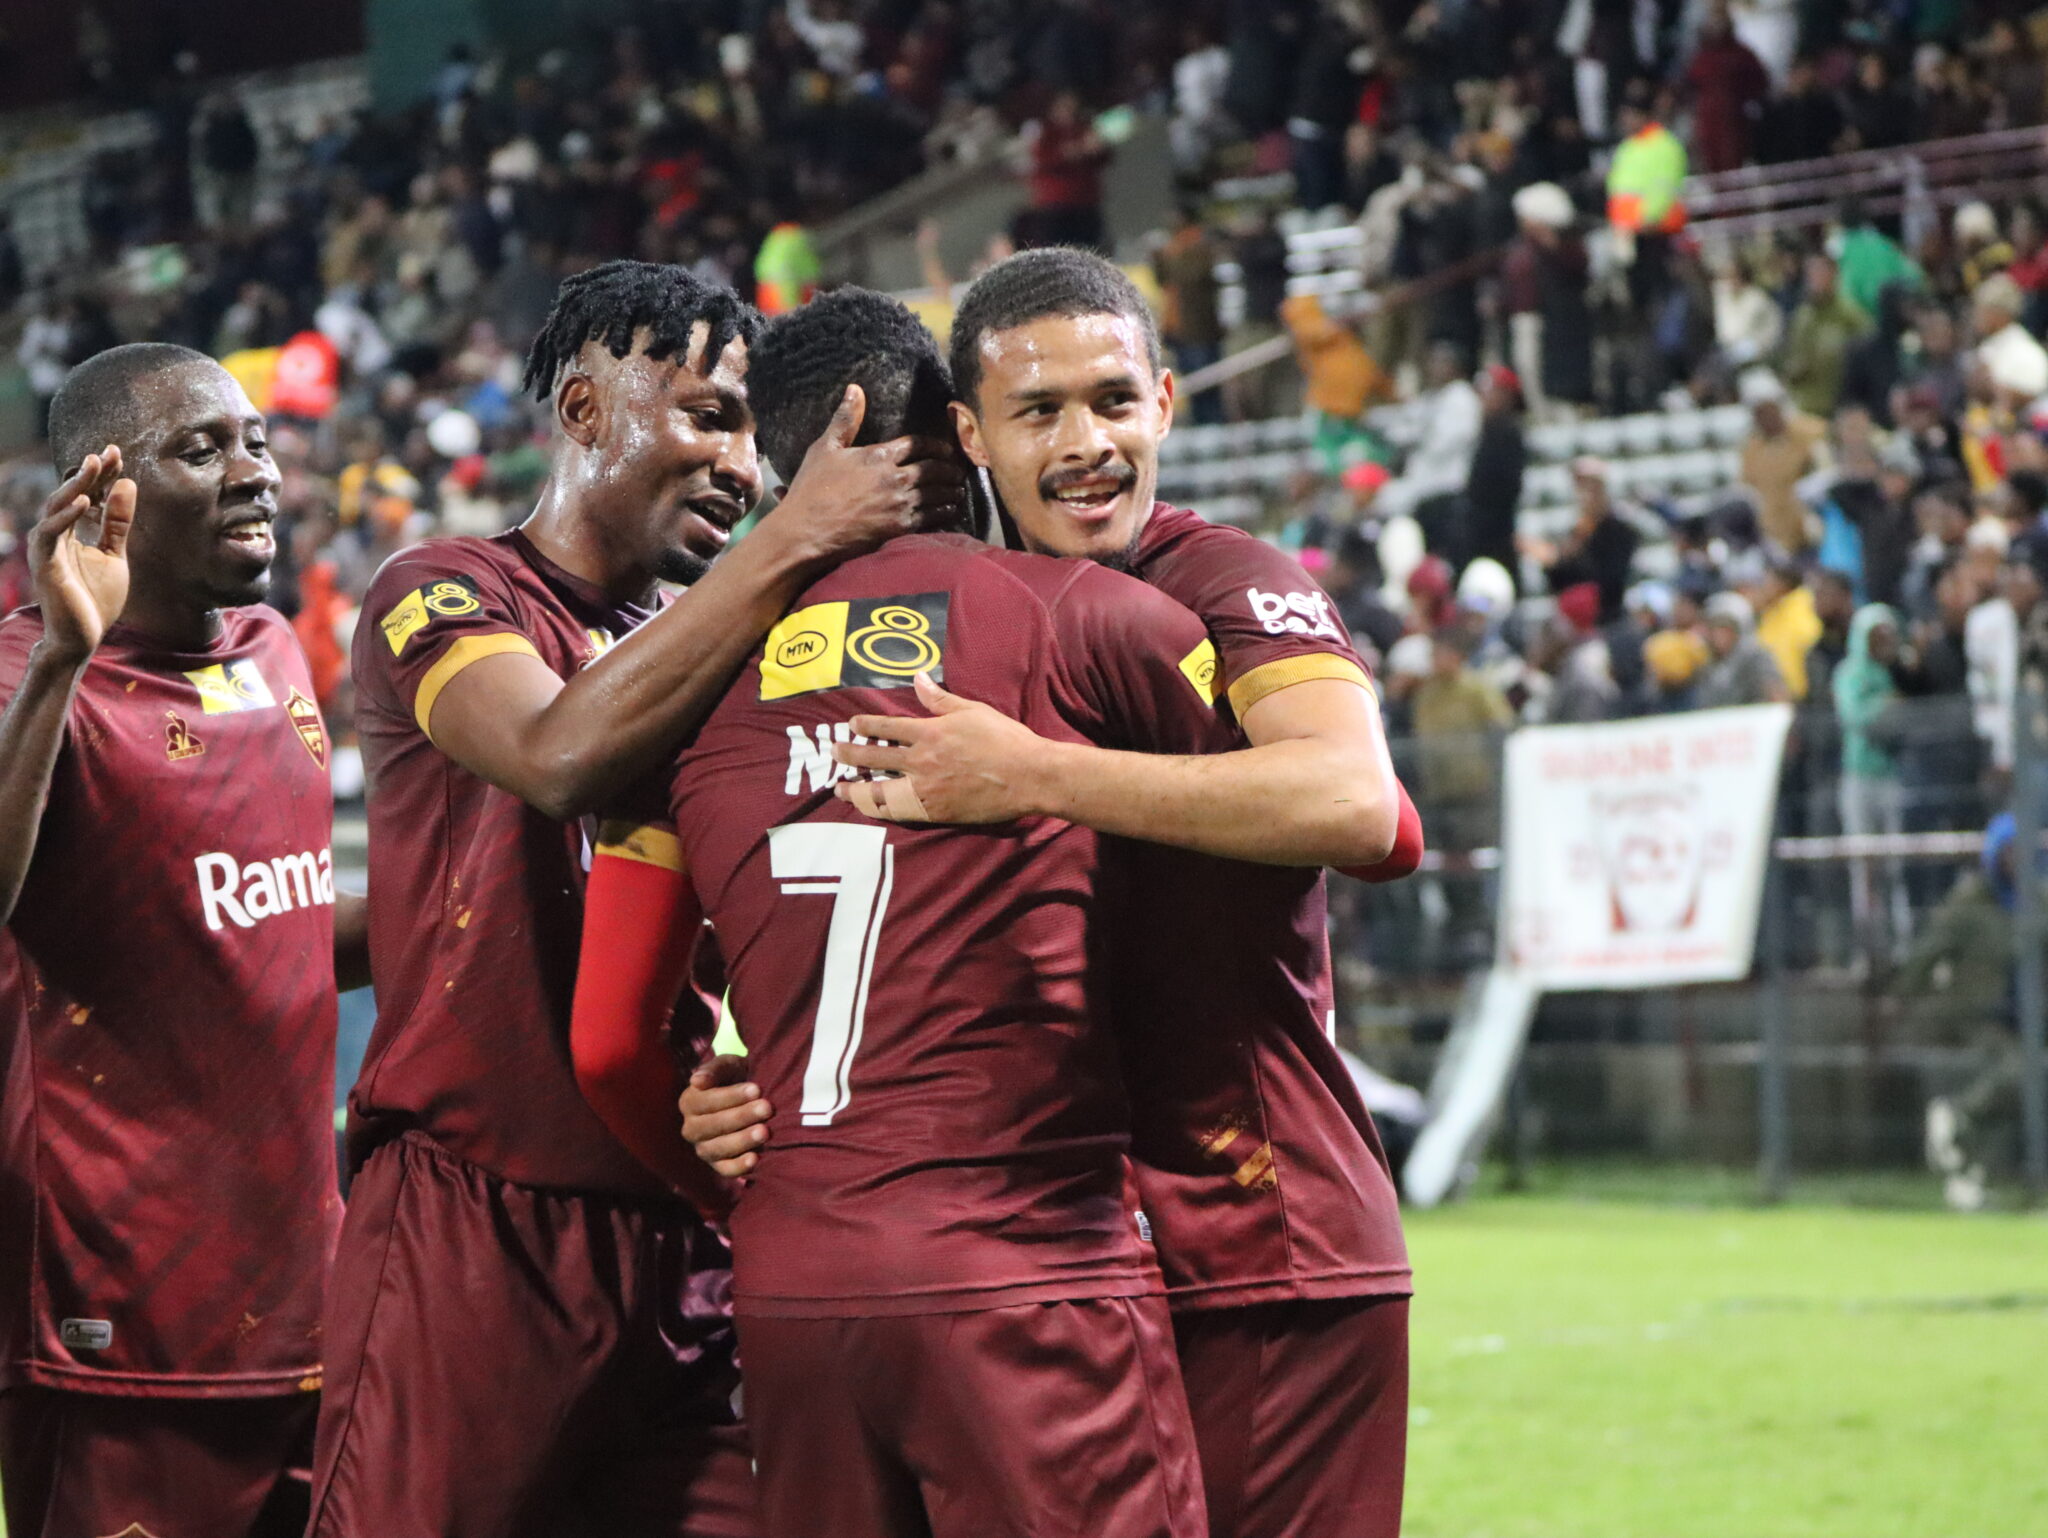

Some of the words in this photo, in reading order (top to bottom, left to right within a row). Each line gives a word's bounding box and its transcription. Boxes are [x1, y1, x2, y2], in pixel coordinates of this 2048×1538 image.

[424, 583, 479, 615] 8
[786, 640, 815, 659] MTN
[846, 605, 942, 676] 8
[194, 848, 336, 931] Rama
[767, 822, 894, 1125] 7
